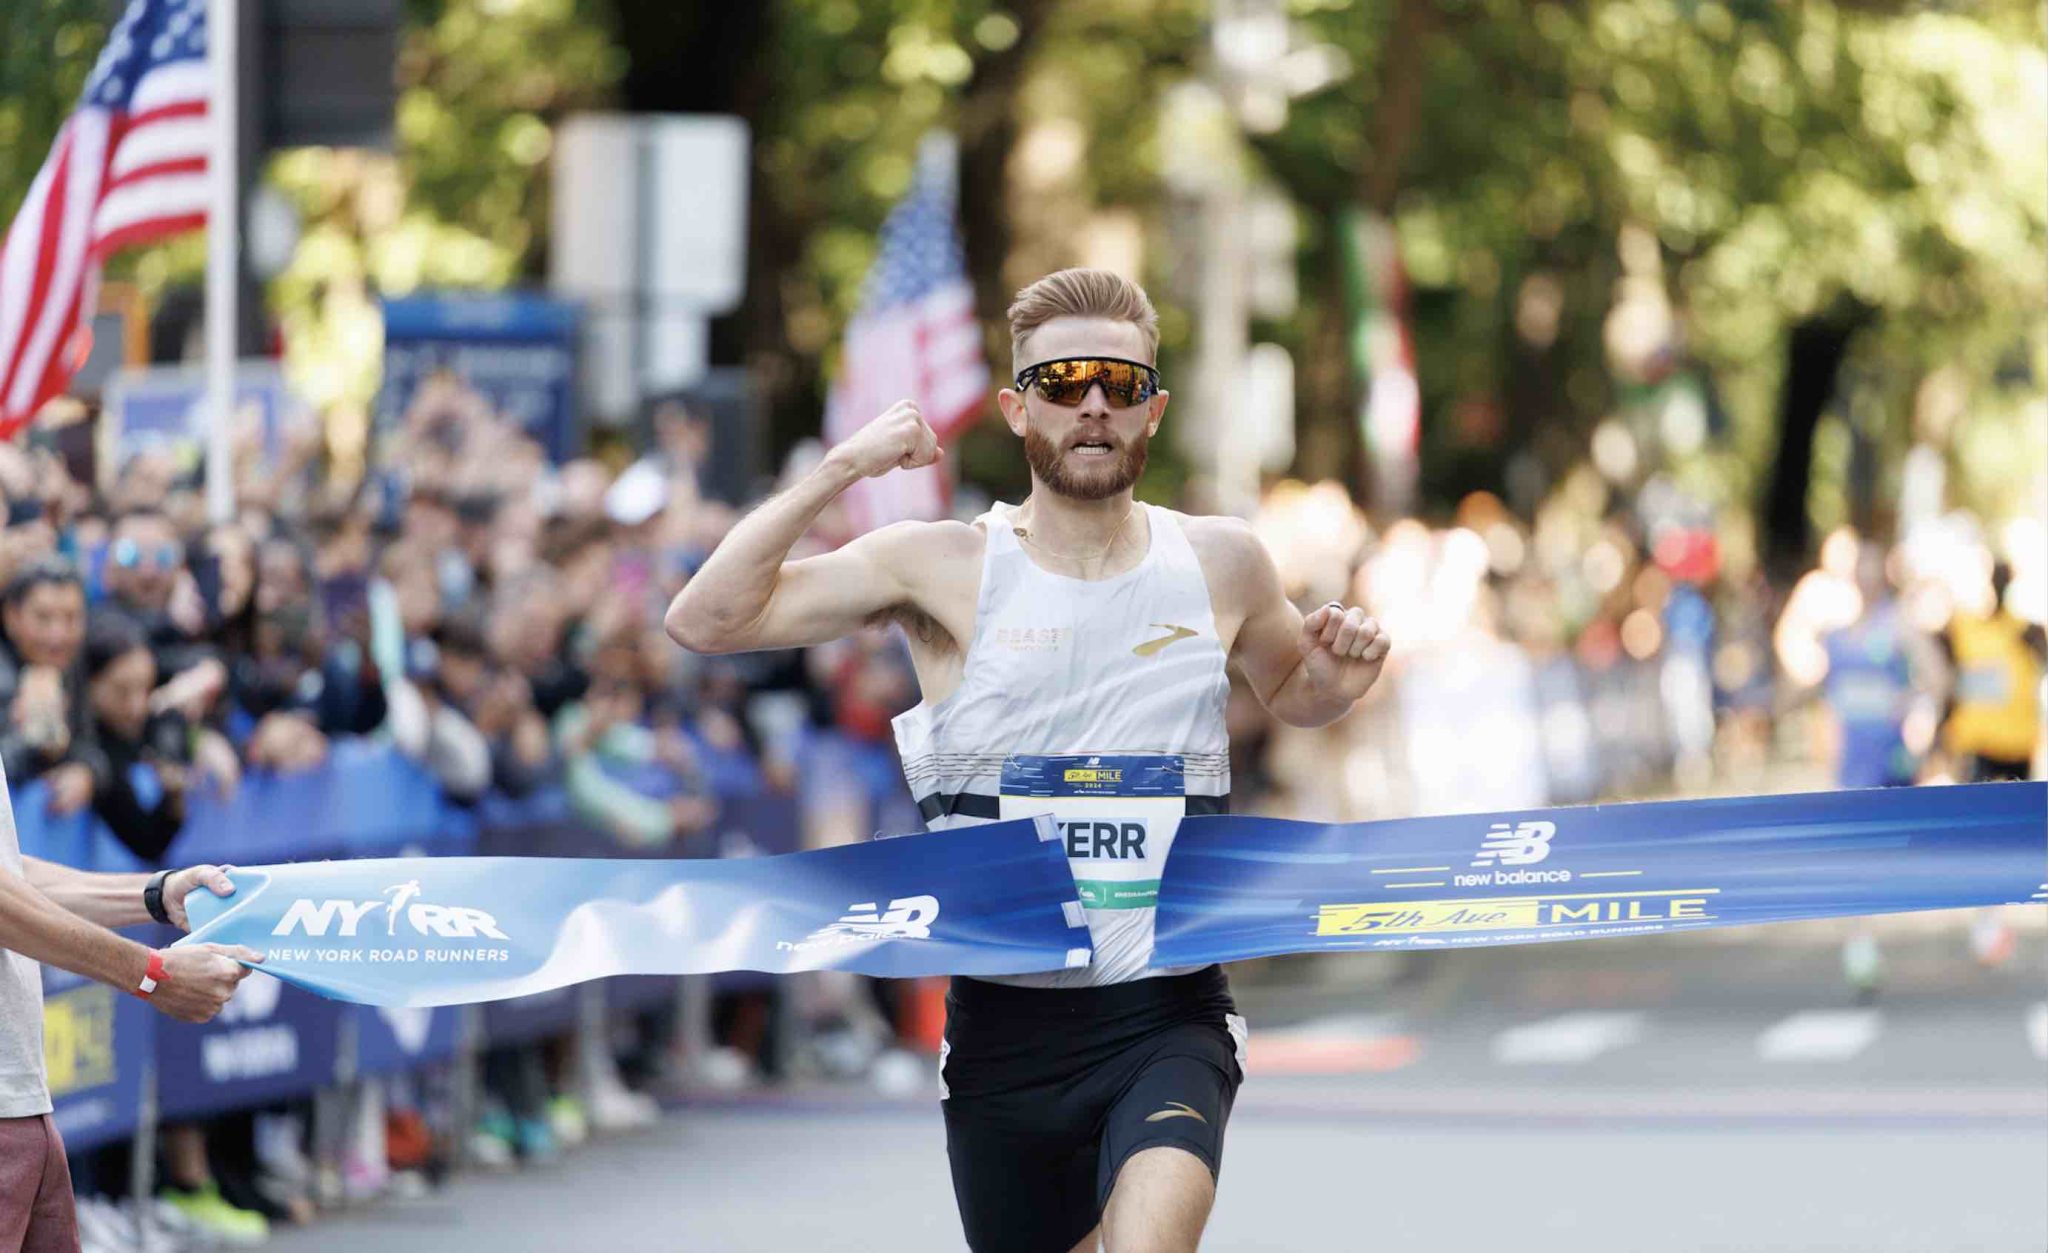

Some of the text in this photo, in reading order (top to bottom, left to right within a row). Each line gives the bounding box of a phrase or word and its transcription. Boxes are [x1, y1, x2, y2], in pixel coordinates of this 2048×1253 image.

[1097, 771, 1121, 780] MILE
[1057, 822, 1146, 859] ERR
[1454, 869, 1572, 887] new balance
[1341, 910, 1424, 932] 5th
[1551, 898, 1707, 923] MILE
[1493, 932, 1537, 941] YORK
[1540, 929, 1586, 938] ROAD
[268, 949, 509, 962] NEW YORK ROAD RUNNERS
